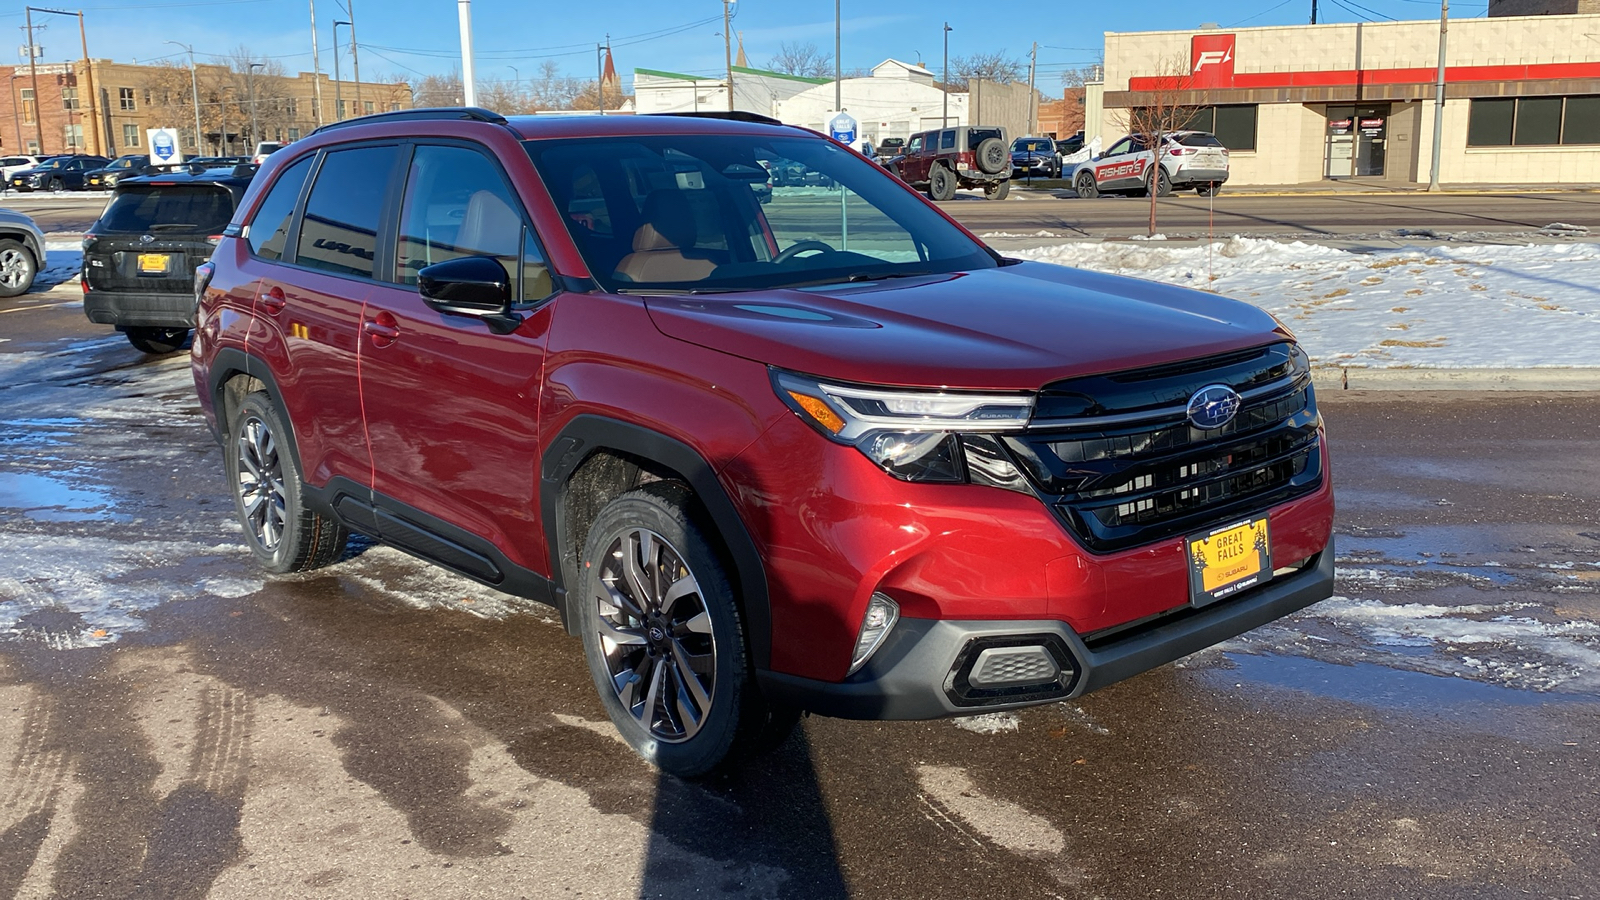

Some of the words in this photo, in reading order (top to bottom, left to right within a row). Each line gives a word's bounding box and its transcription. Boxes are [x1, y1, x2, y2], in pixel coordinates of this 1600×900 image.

[1098, 161, 1142, 179] FISHER'S
[1216, 531, 1243, 549] GREAT
[1217, 543, 1244, 562] FALLS
[1225, 565, 1248, 578] SUBARU
